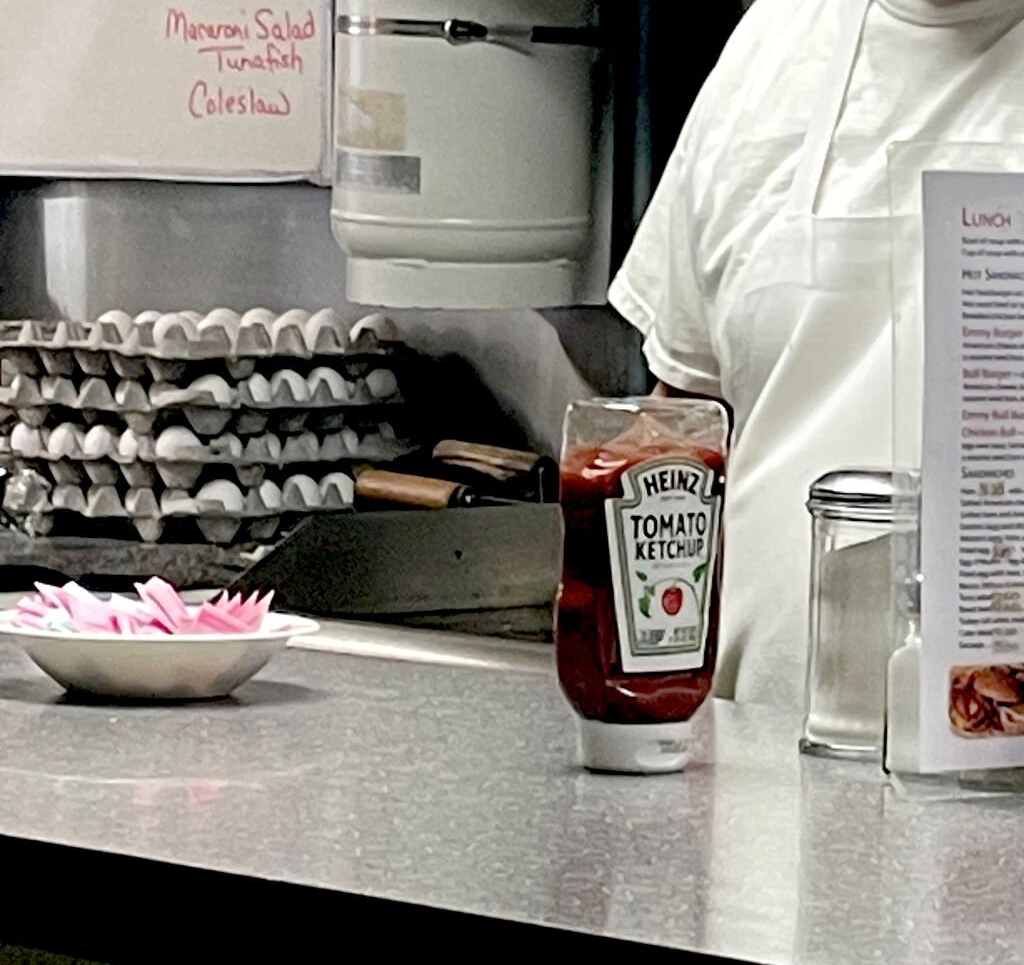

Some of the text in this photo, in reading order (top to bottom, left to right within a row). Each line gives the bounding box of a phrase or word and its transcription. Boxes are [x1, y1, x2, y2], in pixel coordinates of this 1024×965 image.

[255, 8, 315, 40] Salad
[188, 79, 291, 118] Coleslaw
[643, 469, 701, 497] HEINZ
[630, 511, 707, 540] TOMATO
[635, 538, 705, 561] KETCHUP
